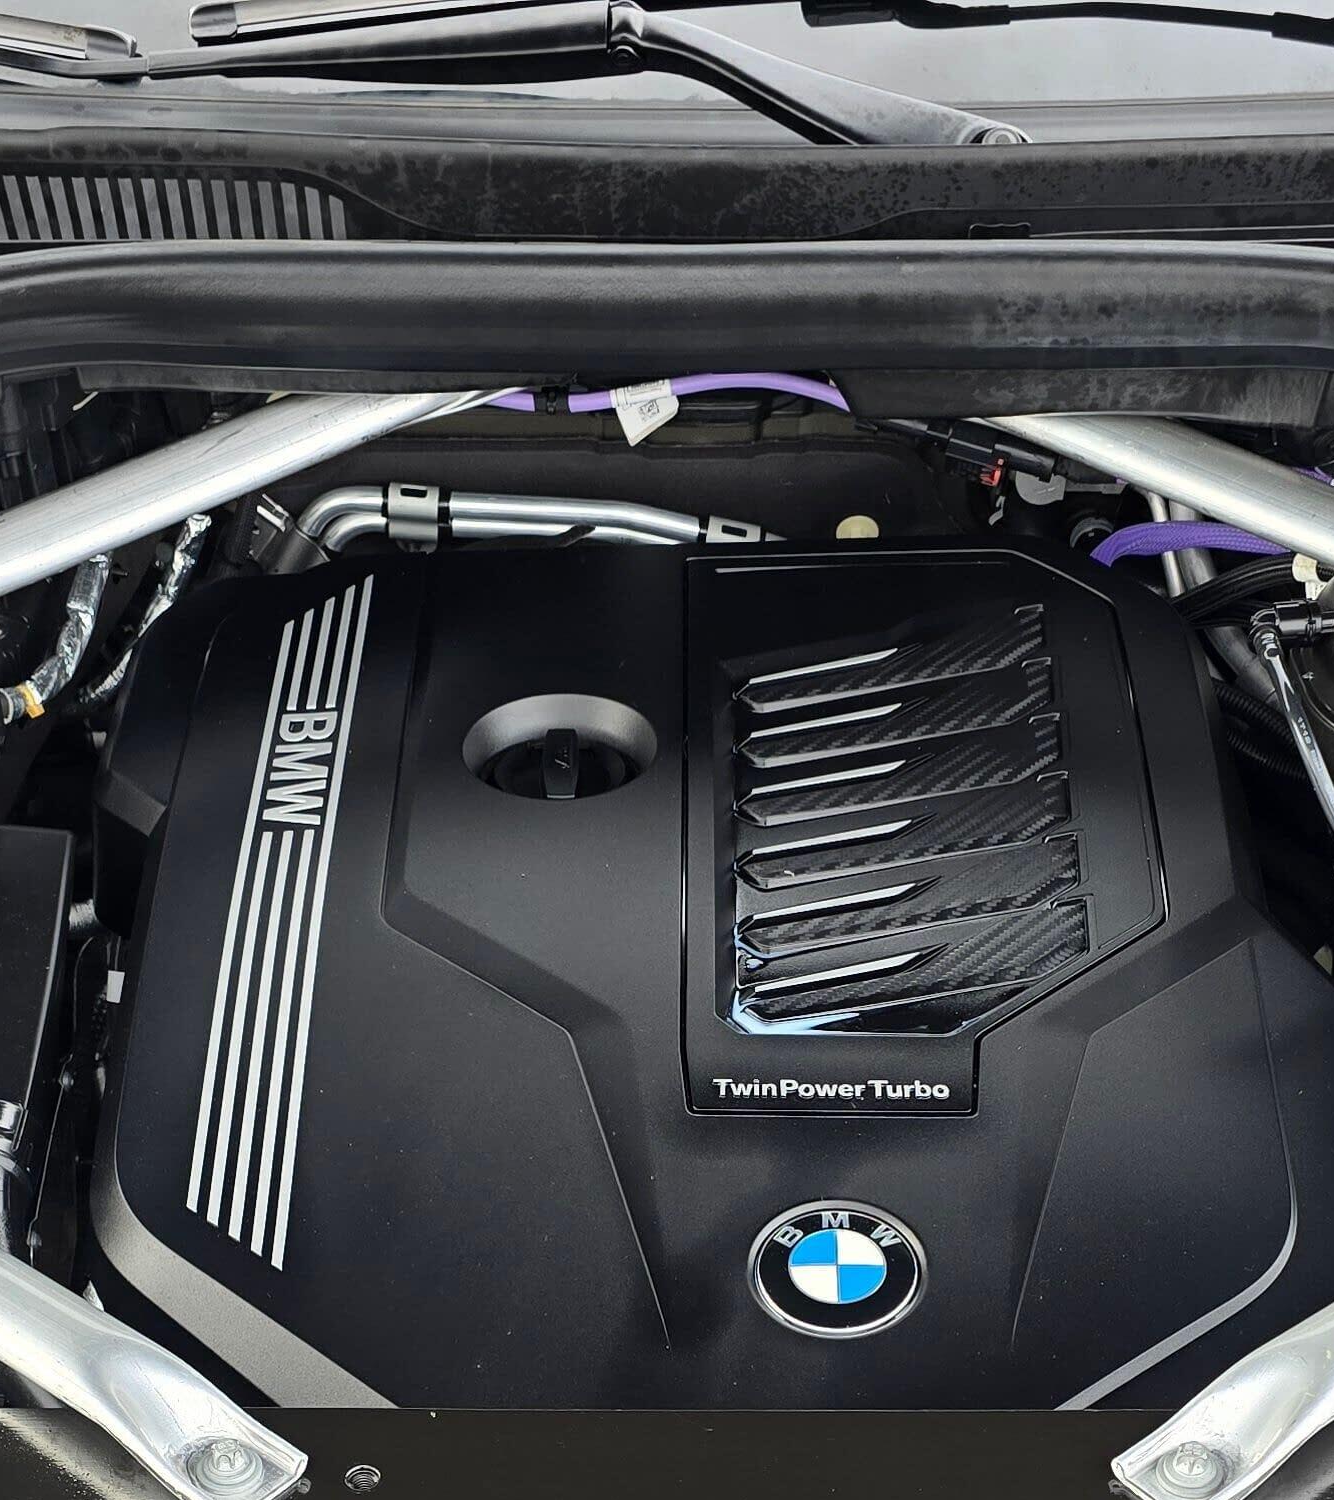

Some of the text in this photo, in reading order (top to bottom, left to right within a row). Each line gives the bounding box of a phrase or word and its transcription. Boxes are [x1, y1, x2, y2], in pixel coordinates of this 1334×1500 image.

[262, 711, 338, 825] BMW
[867, 1079, 950, 1099] Turbo
[773, 1210, 902, 1249] BMW
